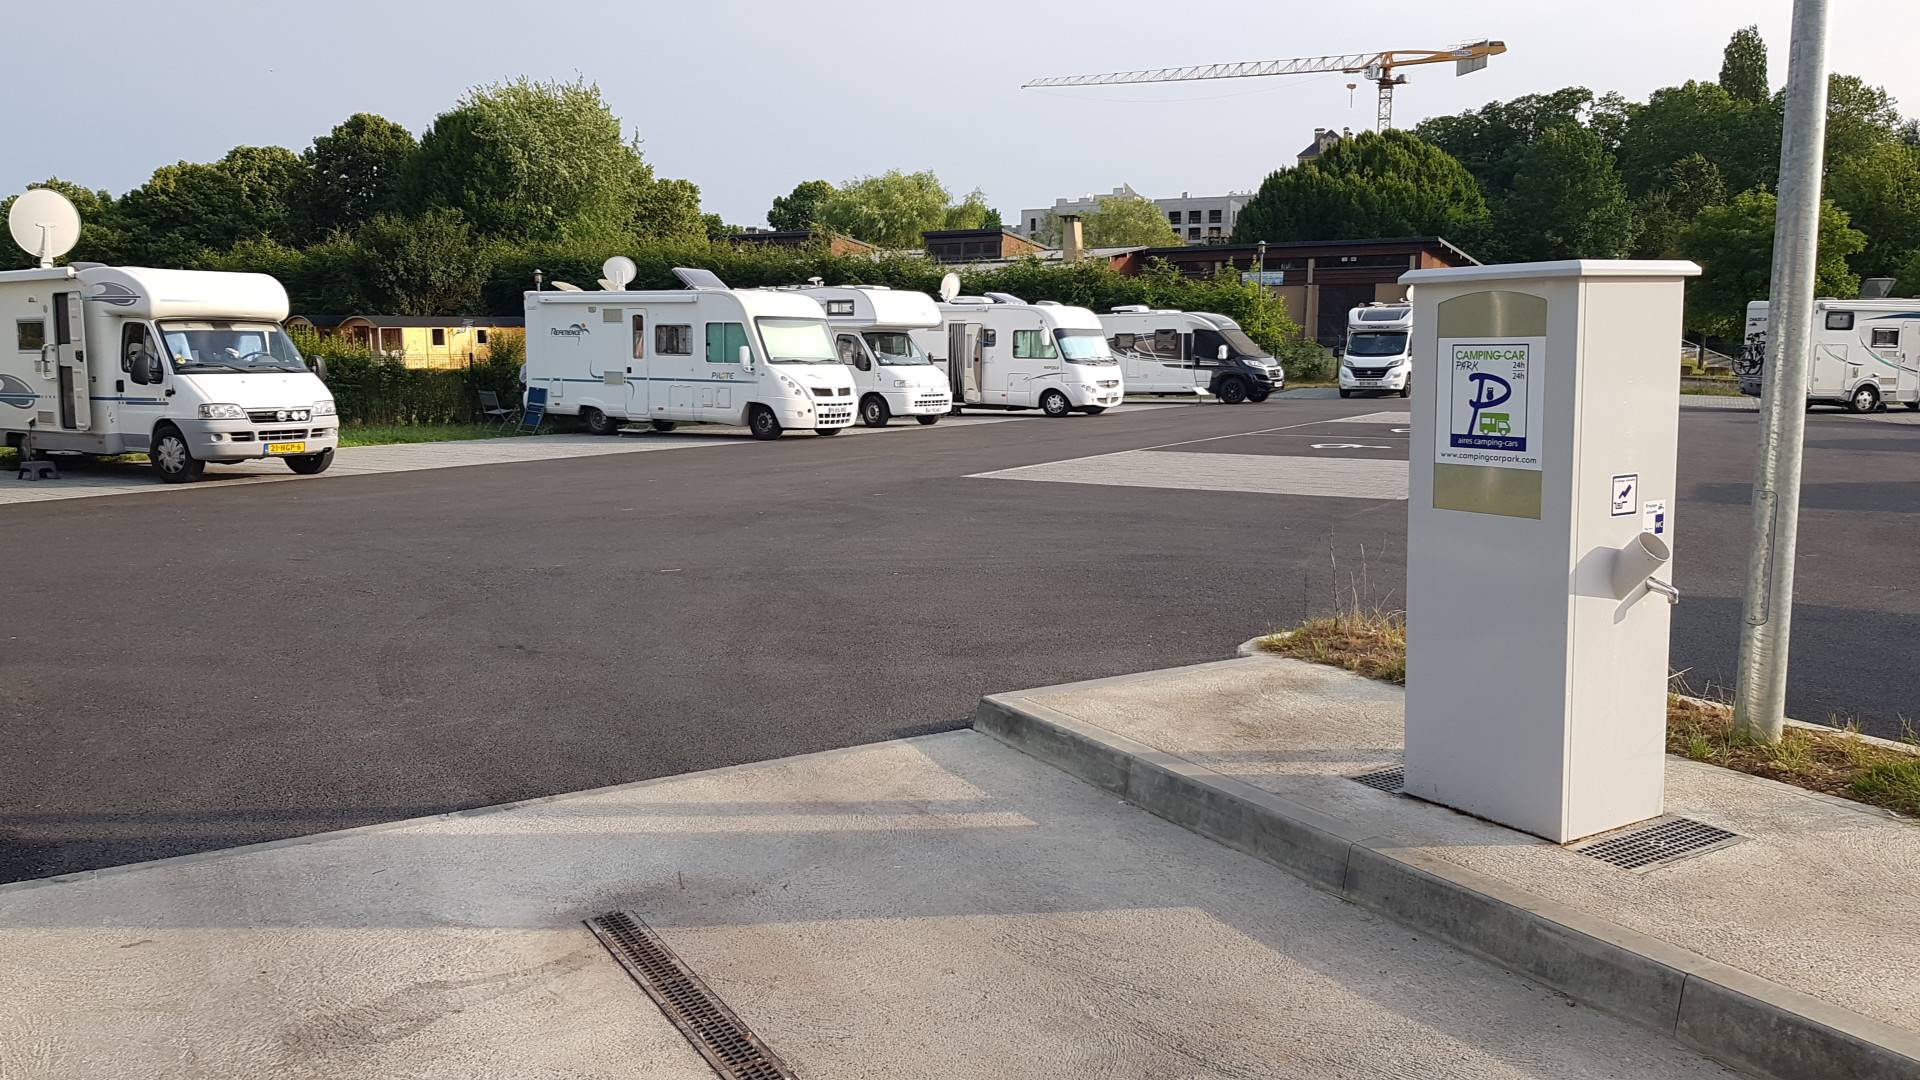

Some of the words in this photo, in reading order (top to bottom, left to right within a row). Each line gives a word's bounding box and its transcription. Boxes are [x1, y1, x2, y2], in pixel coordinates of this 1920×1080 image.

[1455, 351, 1525, 360] CAMPING-CAR
[1455, 360, 1479, 372] PARK
[1512, 361, 1525, 370] 24h
[1512, 372, 1525, 381] 24h
[1457, 437, 1473, 445] aires
[1473, 439, 1518, 448] camping-cars
[1440, 451, 1537, 464] www.campingcarpark.com
